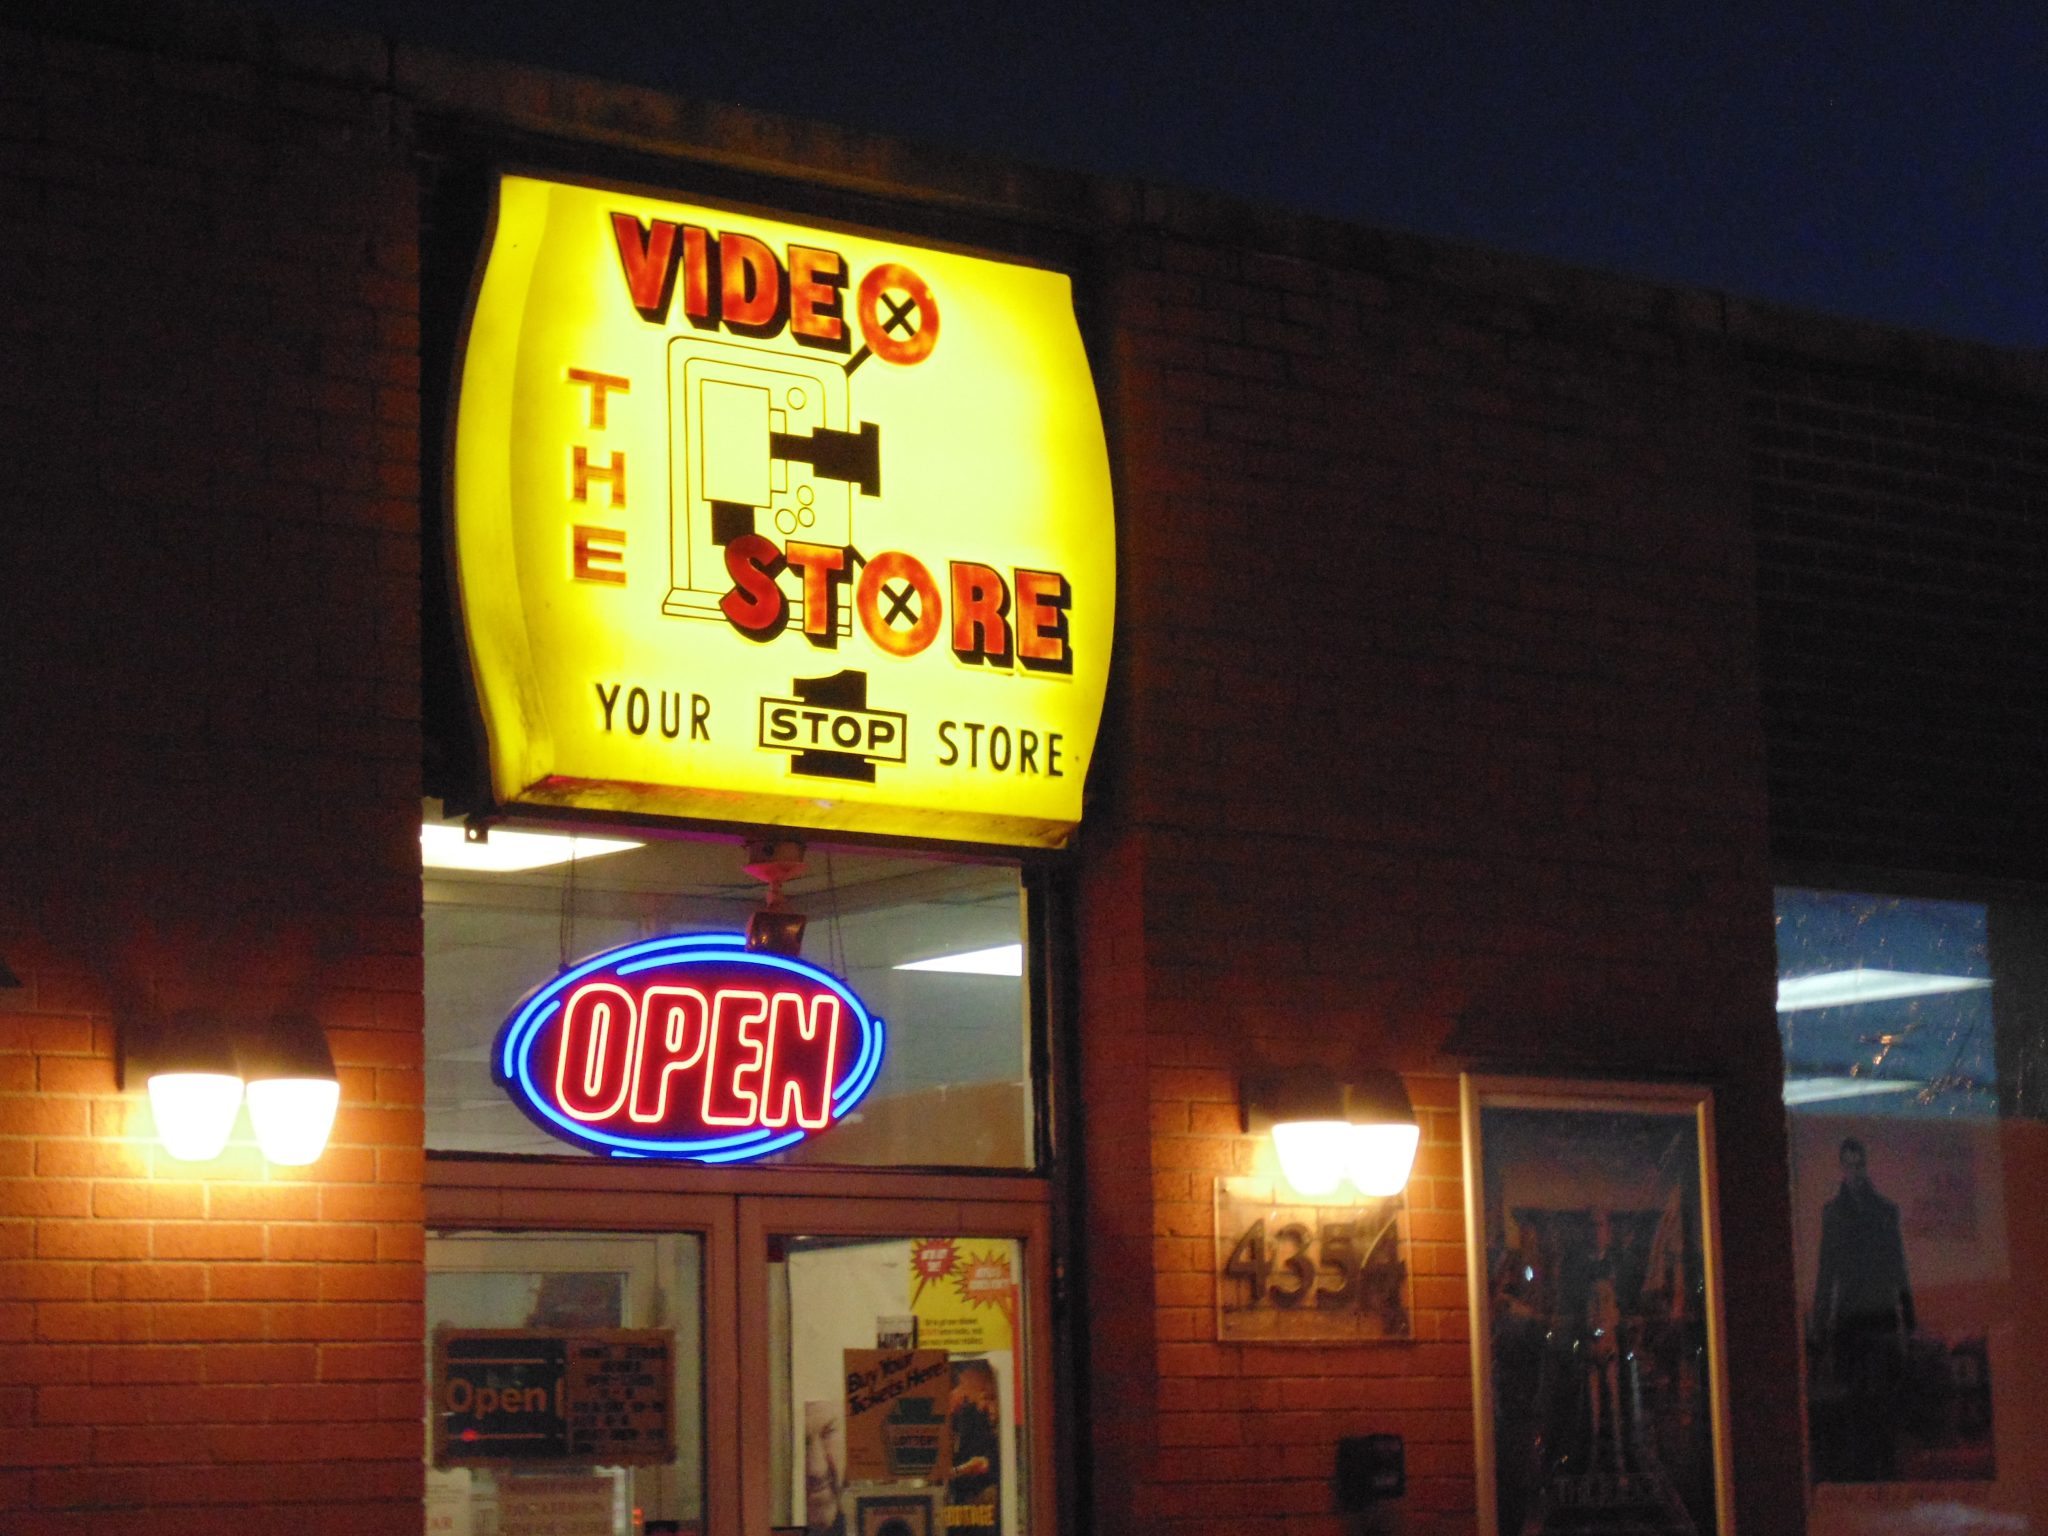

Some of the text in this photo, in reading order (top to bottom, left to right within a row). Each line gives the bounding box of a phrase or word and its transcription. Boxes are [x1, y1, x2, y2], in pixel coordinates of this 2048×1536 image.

[610, 211, 941, 366] VIDEO
[568, 366, 630, 587] THE
[719, 534, 1073, 675] STORE
[595, 683, 712, 742] YOUR
[770, 713, 896, 748] STOP
[939, 721, 1065, 777] STORE
[555, 982, 841, 1130] OPEN
[448, 1377, 548, 1420] Open
